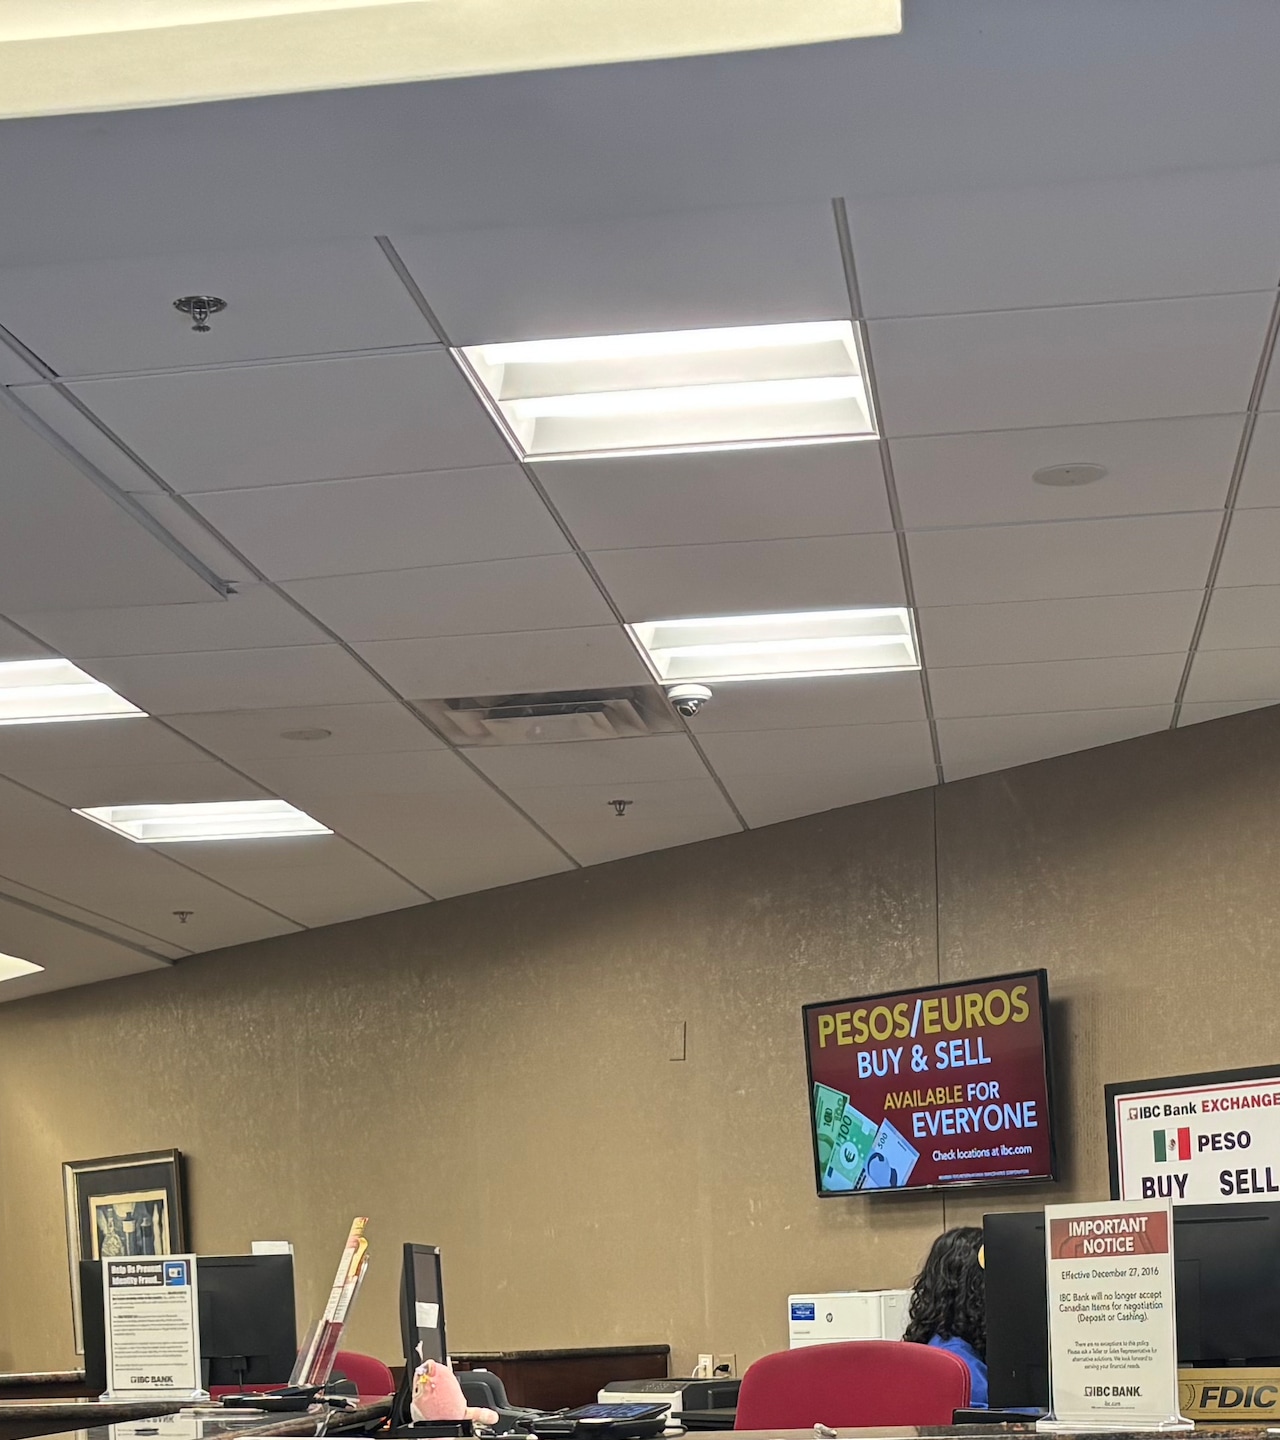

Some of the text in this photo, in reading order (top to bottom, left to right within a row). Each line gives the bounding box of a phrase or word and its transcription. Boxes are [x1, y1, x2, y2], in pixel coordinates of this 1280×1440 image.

[818, 986, 1030, 1048] PESOS/EUROS
[857, 1037, 992, 1079] BUY & SELL
[884, 1081, 1000, 1110] AVAILABLE FOR
[912, 1101, 1038, 1138] EVERYONE
[1139, 1105, 1161, 1119] IBC
[1164, 1102, 1197, 1117] Bank
[838, 1115, 852, 1140] 100
[877, 1132, 888, 1150] 500
[1197, 1130, 1251, 1152] PESO
[932, 1145, 1032, 1161] Check locations at ibc.com
[1142, 1167, 1279, 1199] BUY SELL
[1068, 1216, 1148, 1237] IMPORTANT
[1083, 1236, 1135, 1255] NOTICE
[111, 1264, 162, 1275] Help Us Prevent
[1061, 1267, 1159, 1280] Effective December 27, 2016
[111, 1276, 138, 1285] Identity
[1059, 1293, 1071, 1302] IBC
[1073, 1293, 1089, 1302] Bank
[1091, 1292, 1103, 1300] will
[1114, 1291, 1137, 1301] longer
[1139, 1291, 1162, 1301] accept
[1059, 1303, 1090, 1312] Canadian
[1112, 1302, 1122, 1310] for
[1124, 1301, 1163, 1312] negotiation
[1077, 1313, 1106, 1324] (Deposit
[1117, 1312, 1148, 1322] Cashing).
[137, 1375, 173, 1384] IBC BANK
[1093, 1386, 1140, 1397] IBC BANK
[1199, 1385, 1278, 1408] FDIC
